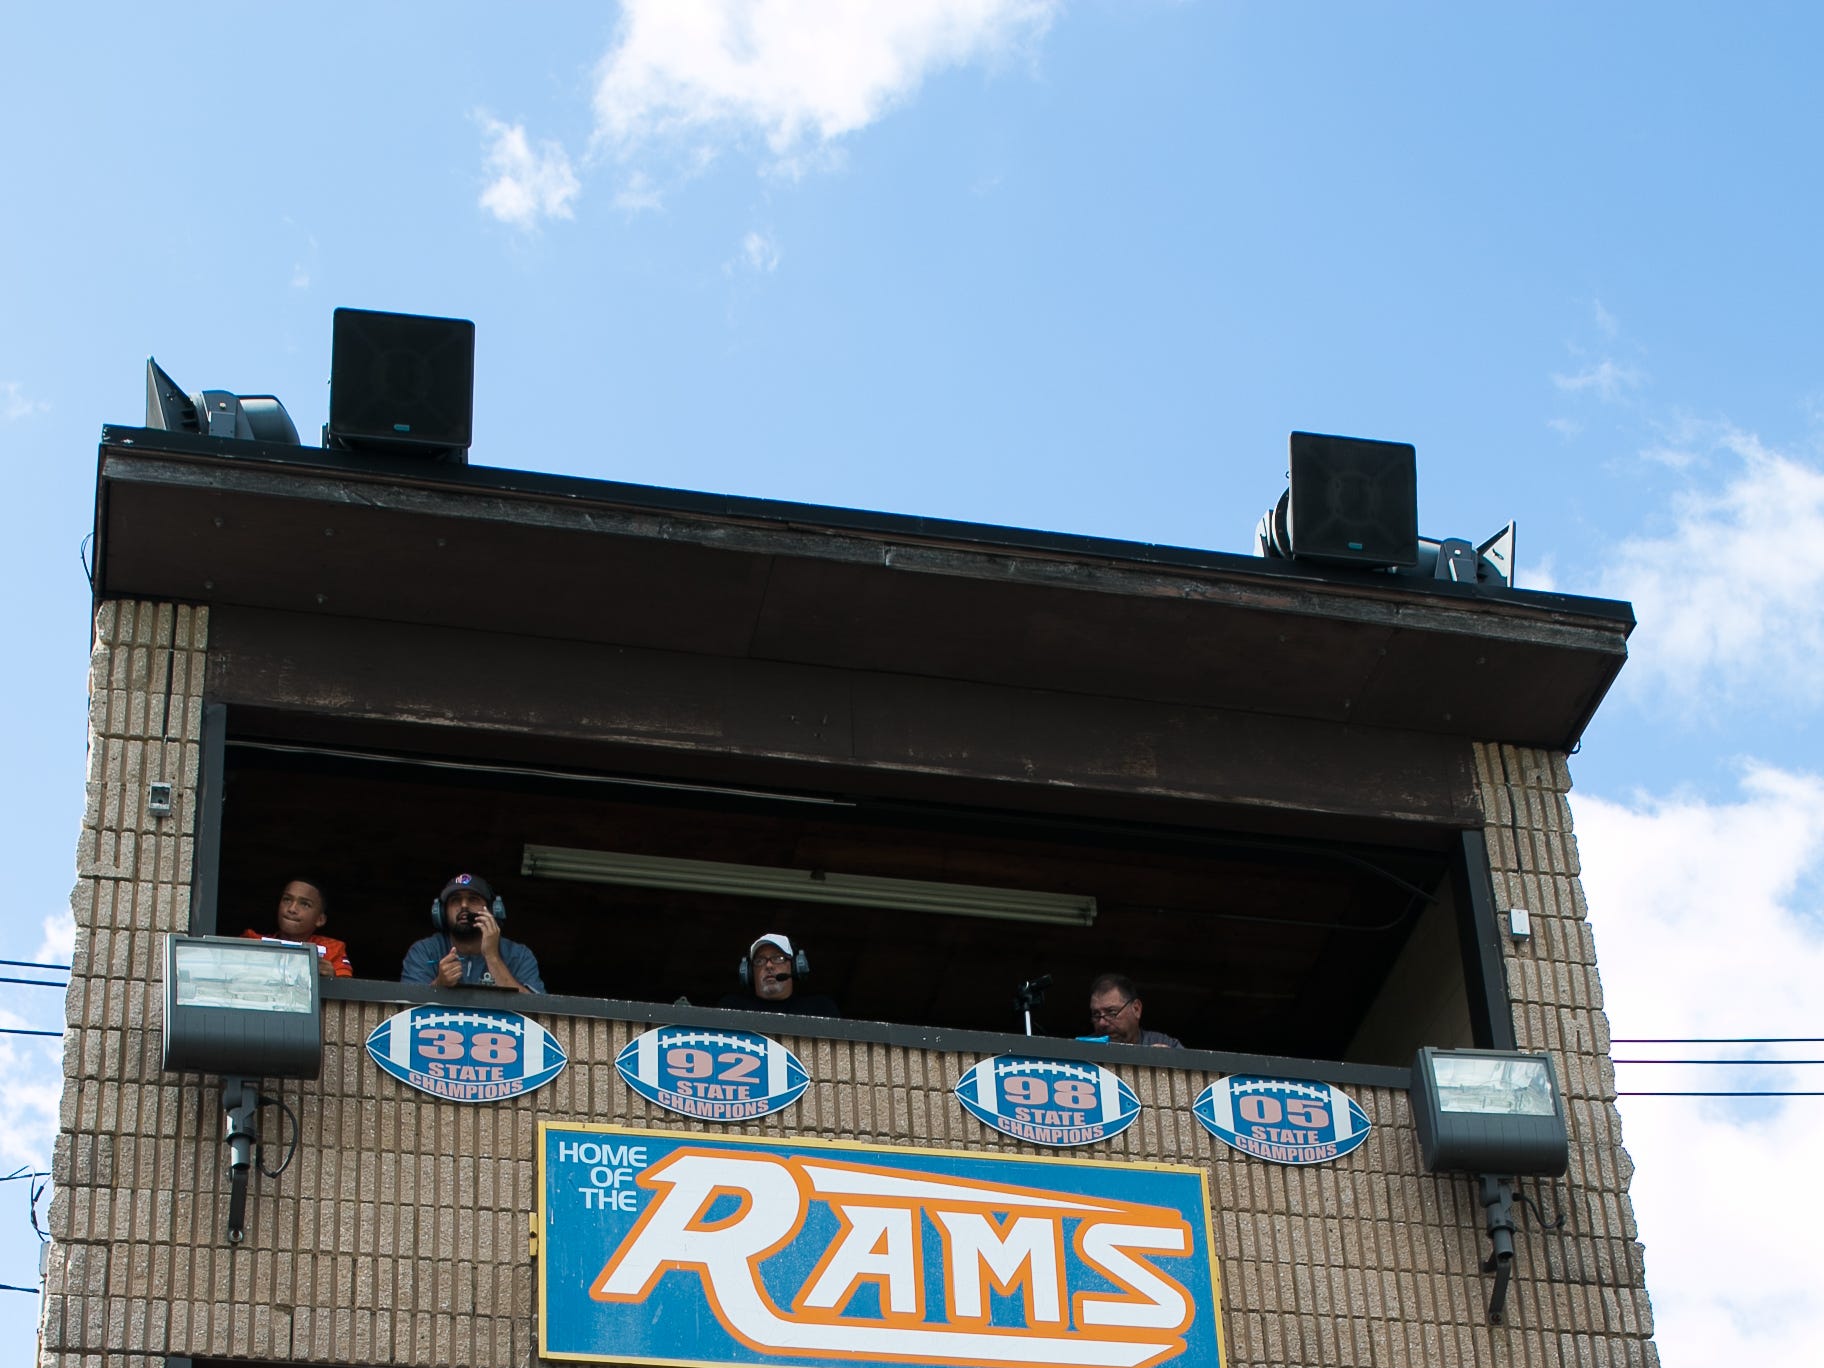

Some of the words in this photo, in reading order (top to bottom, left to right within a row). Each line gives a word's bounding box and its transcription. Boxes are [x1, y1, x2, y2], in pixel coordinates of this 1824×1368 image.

[417, 1028, 518, 1064] 38
[428, 1062, 504, 1081] STATE
[666, 1047, 761, 1085] 92
[408, 1071, 524, 1099] CHAMPIONS
[676, 1080, 750, 1101] STATE
[1003, 1076, 1097, 1110] 98
[658, 1090, 769, 1119] CHAMPIONS
[1015, 1106, 1085, 1126] STATE
[1239, 1095, 1330, 1128] 05
[997, 1117, 1104, 1144] CHAMPIONS
[1251, 1125, 1319, 1145] STATE
[558, 1141, 648, 1168] HOME
[1235, 1135, 1338, 1162] CHAMPIONS
[590, 1166, 633, 1188] OF
[578, 1187, 637, 1212] THE
